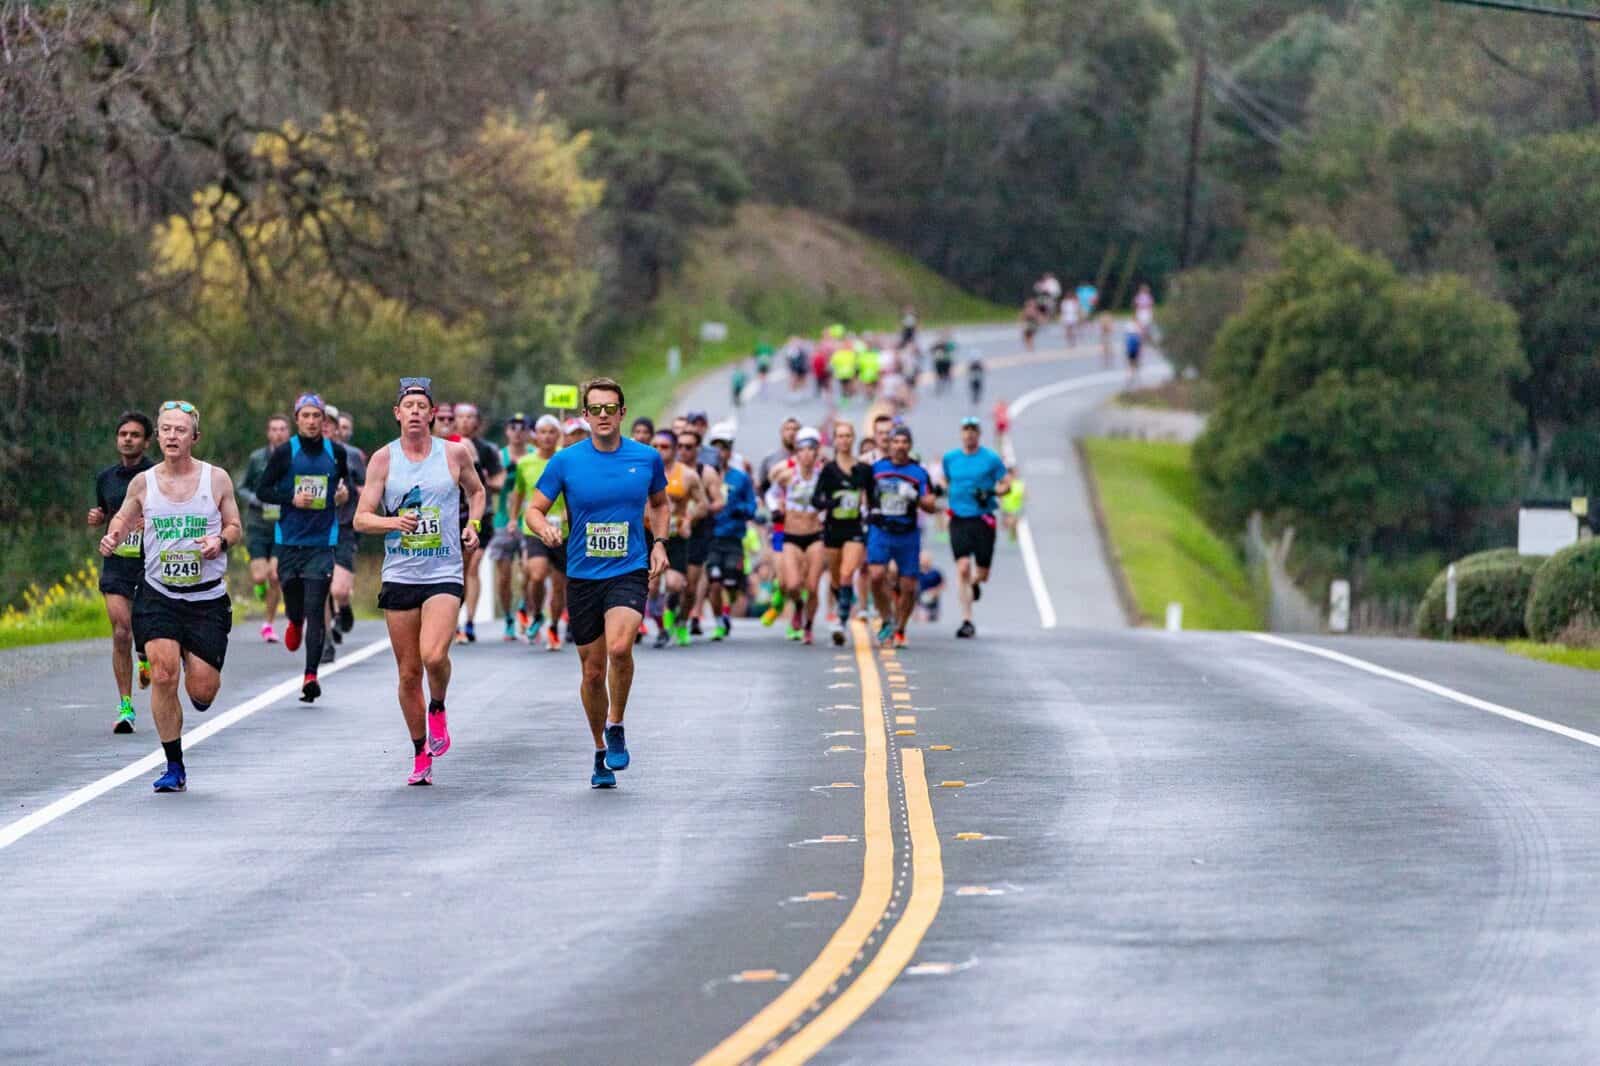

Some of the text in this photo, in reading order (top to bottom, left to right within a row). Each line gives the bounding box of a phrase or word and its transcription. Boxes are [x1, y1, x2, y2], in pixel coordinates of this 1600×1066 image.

[152, 515, 208, 529] That's Fine
[405, 519, 439, 535] 215
[590, 535, 625, 550] 4069
[164, 561, 199, 577] 4249
